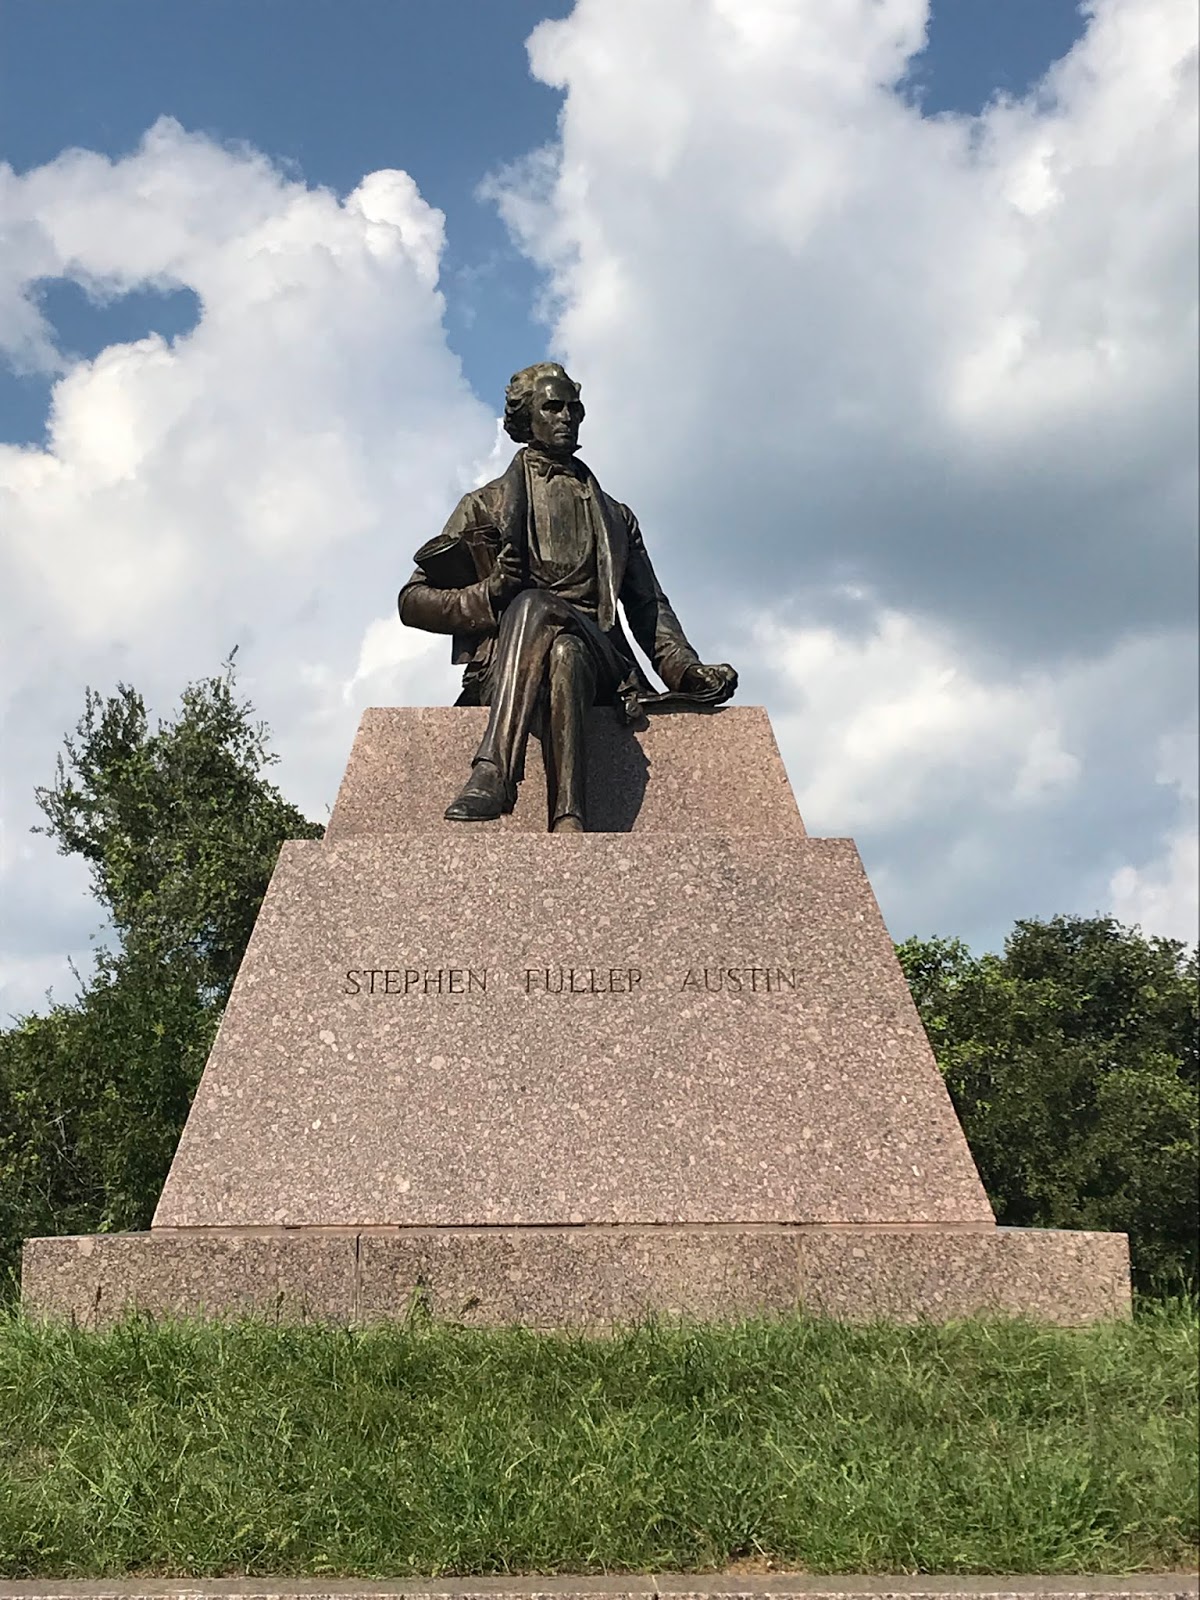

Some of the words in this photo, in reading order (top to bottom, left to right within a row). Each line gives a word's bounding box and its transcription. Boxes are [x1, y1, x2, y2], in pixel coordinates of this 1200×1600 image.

[345, 969, 488, 995] STEPHEN
[525, 968, 644, 993] FULLER
[681, 967, 797, 993] AUSTIN
